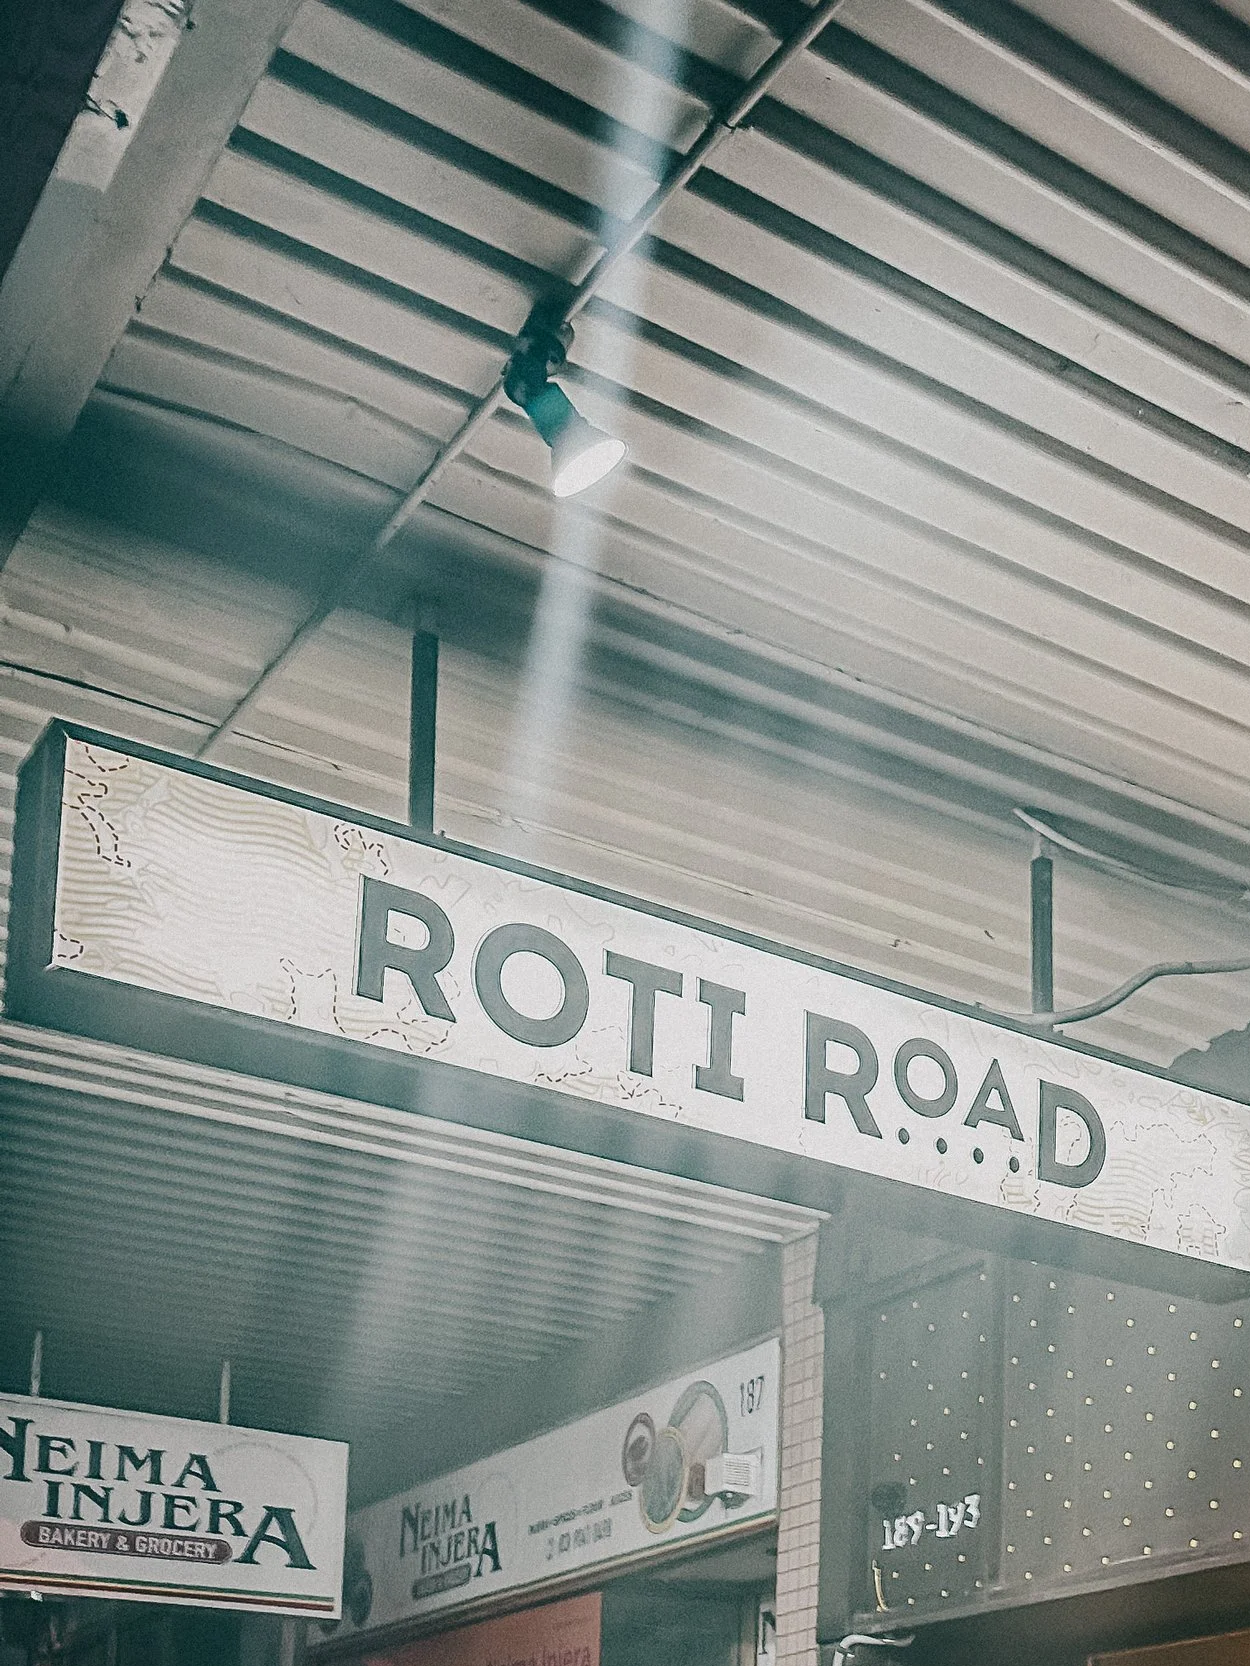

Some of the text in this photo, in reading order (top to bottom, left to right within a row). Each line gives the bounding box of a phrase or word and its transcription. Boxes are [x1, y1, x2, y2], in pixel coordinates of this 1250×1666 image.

[352, 874, 1107, 1188] ROTI ROAD
[739, 1375, 766, 1418] 187
[38, 1526, 218, 1561] BAKERY & GROCERY
[42, 1479, 318, 1571] INJERA
[399, 1494, 473, 1557] NEIMA
[420, 1521, 503, 1579] INJERA
[882, 1493, 981, 1551] 189-193
